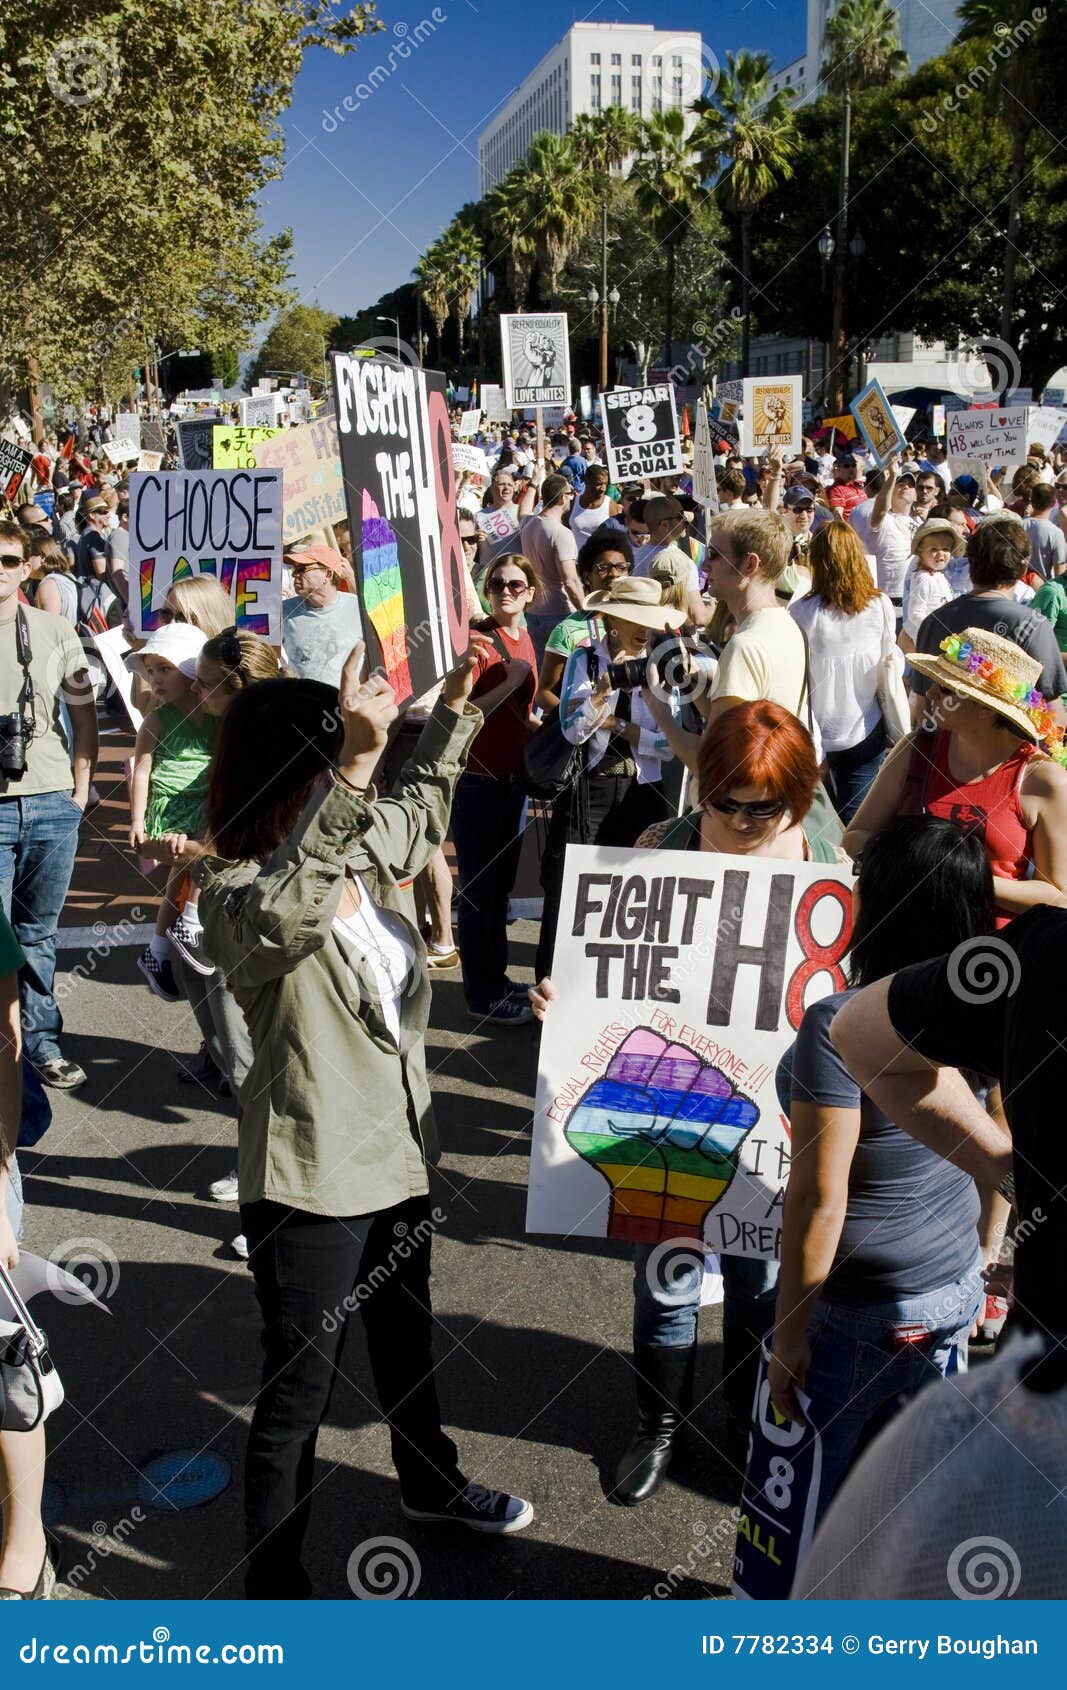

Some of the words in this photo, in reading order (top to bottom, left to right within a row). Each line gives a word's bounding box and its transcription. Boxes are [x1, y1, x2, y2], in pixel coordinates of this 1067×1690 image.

[512, 320, 534, 329] DEFEND
[535, 319, 561, 328] EQUALITY
[334, 355, 409, 438] FIGHT
[515, 388, 535, 402] LOVE
[536, 387, 564, 401] UNITES
[607, 387, 669, 409] SEPAR
[626, 405, 658, 443] 8
[106, 439, 130, 451] LOVE
[233, 441, 251, 453] JU
[615, 448, 633, 463] IS
[639, 442, 675, 459] NOT
[949, 434, 967, 454] H8
[237, 457, 257, 470] LO
[617, 457, 677, 477] EQUAL
[376, 451, 414, 521] THE
[136, 473, 277, 552] CHOOSE
[490, 513, 510, 537] NO
[571, 872, 715, 946] FIGHT
[706, 869, 855, 1033] H8
[585, 943, 681, 1004] THE
[547, 1075, 589, 1125] EQUAL
[580, 1022, 630, 1074] RIGHTS
[650, 1008, 675, 1037] FOR
[716, 1212, 783, 1260] DRE
[764, 1456, 795, 1510] 8
[736, 1514, 782, 1566] ALL
